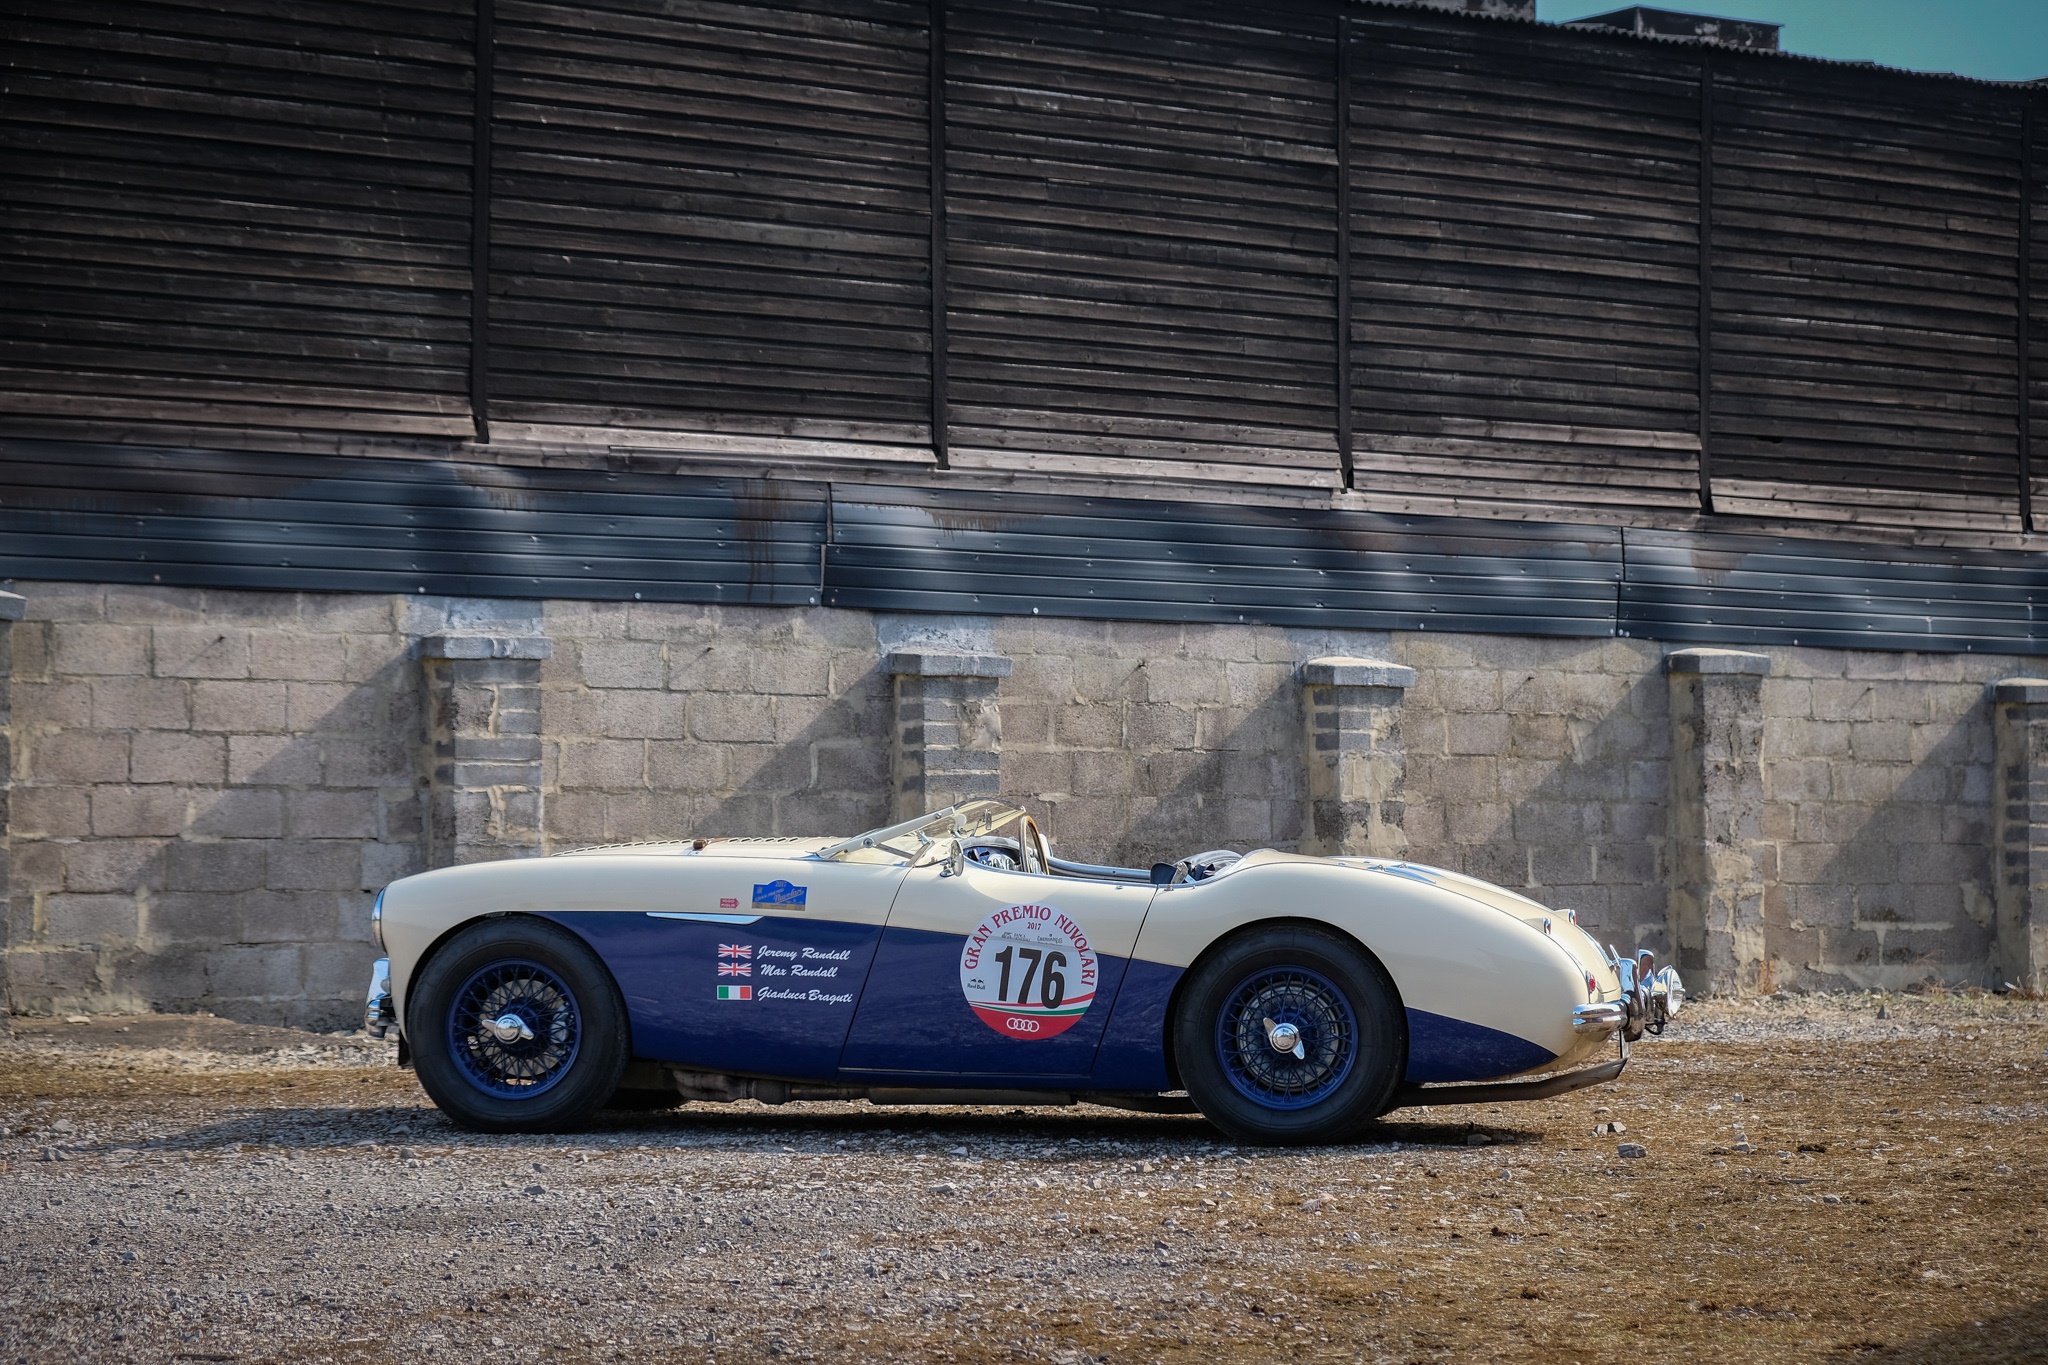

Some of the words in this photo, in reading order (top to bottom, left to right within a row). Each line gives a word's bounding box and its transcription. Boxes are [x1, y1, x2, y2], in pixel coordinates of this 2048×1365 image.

[1027, 922, 1042, 930] 2017
[757, 945, 798, 960] Jeremy
[801, 947, 851, 961] Randall
[964, 924, 993, 970] GRAN
[991, 905, 1051, 928] PREMIO
[1054, 914, 1096, 986] NUVOLARI
[760, 964, 787, 976] Max
[790, 964, 838, 978] Randall
[995, 945, 1067, 1009] 176
[757, 986, 807, 1001] Gianluca
[808, 989, 853, 1005] Braguti
